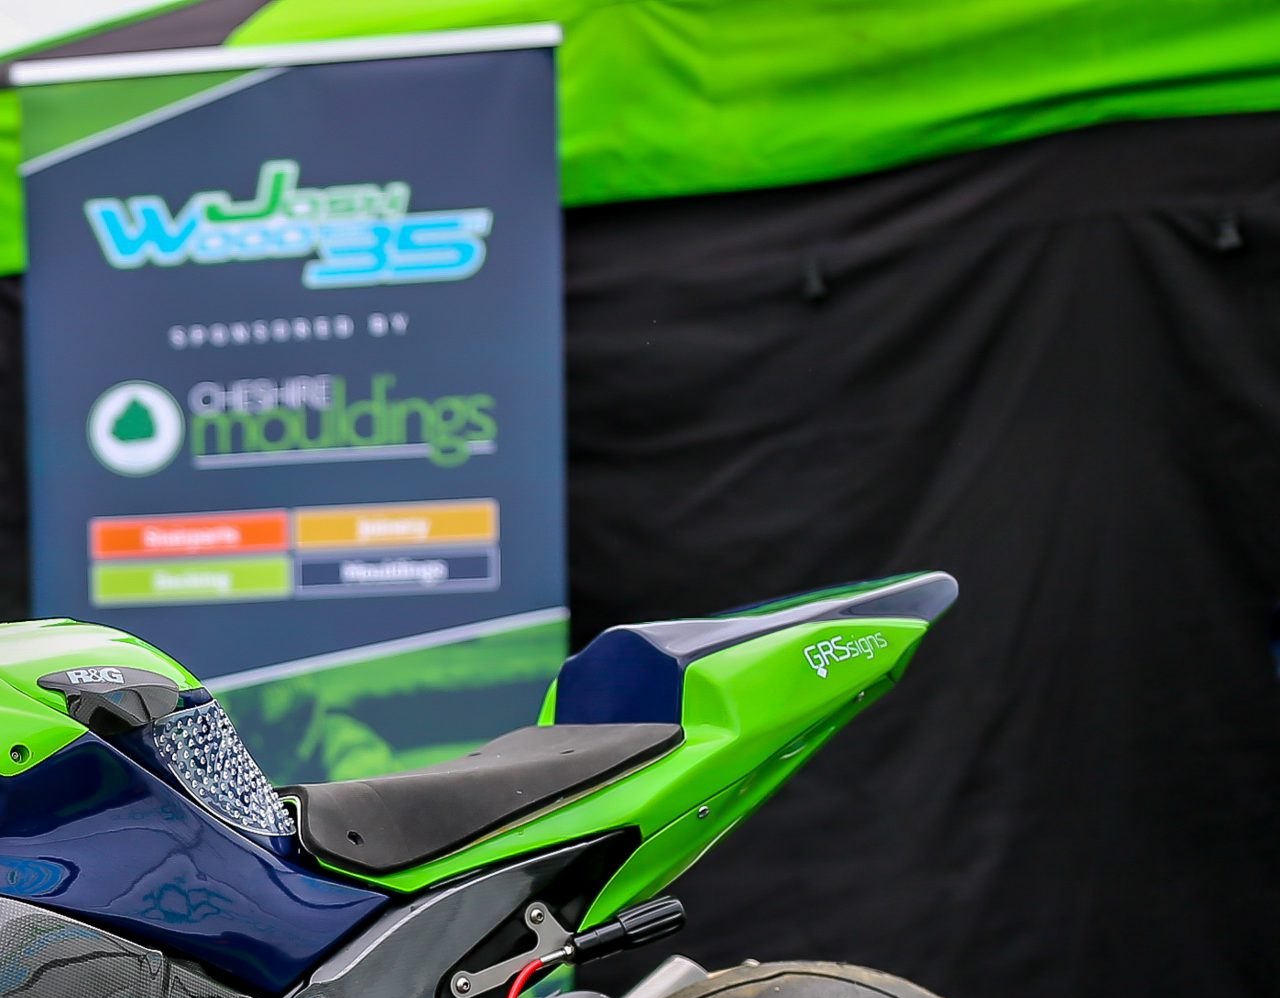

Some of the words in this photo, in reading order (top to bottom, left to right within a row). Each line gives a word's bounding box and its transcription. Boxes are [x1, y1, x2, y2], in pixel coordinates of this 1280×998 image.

[188, 374, 333, 418] CHESHIRE
[191, 372, 497, 468] mouldings
[65, 667, 125, 684] R&G
